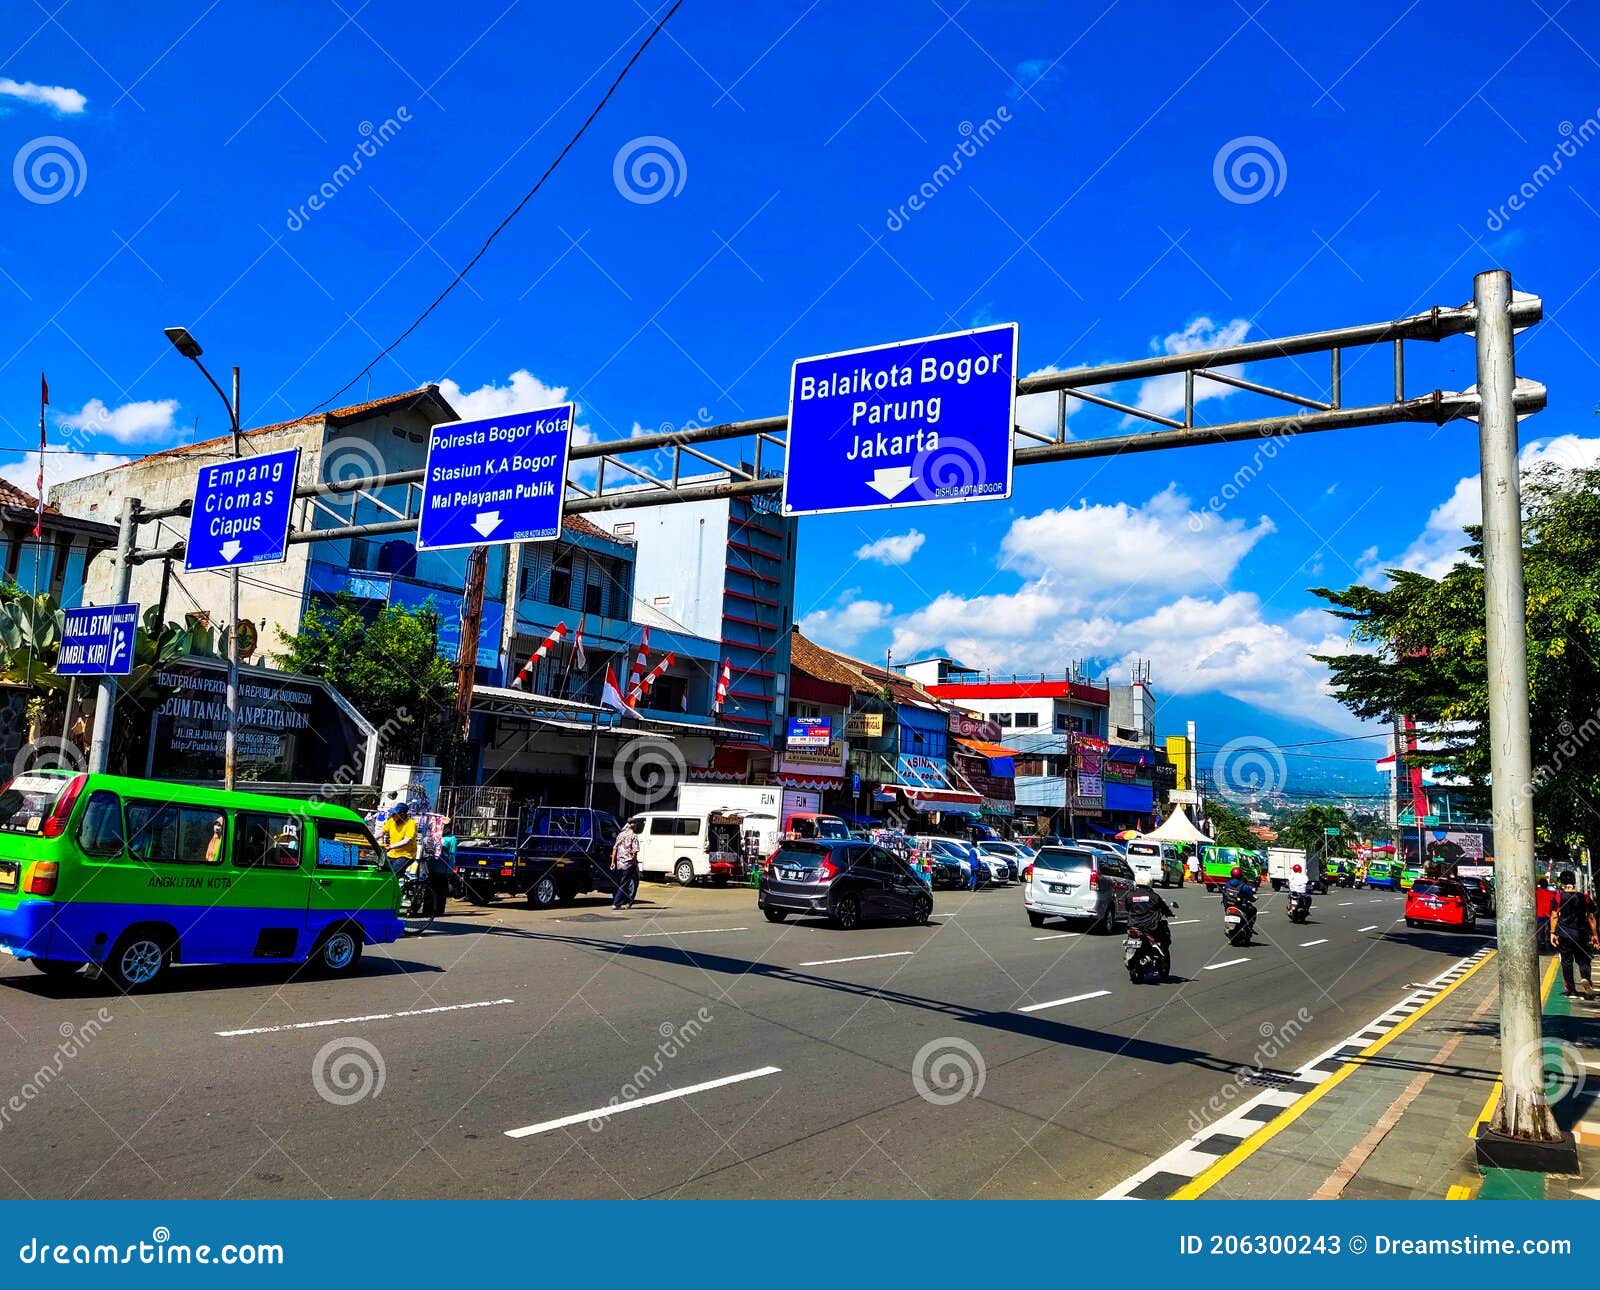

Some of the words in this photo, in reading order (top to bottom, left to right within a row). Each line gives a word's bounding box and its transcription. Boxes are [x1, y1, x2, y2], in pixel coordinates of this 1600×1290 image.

[800, 364, 912, 401] Balaikota
[920, 353, 1003, 385] Bogor
[851, 396, 942, 427] Parung
[431, 430, 485, 451] Polresta
[489, 425, 531, 443] Bogor
[535, 418, 568, 435] Kota
[846, 430, 940, 460] Jakarta
[208, 462, 283, 488] Empang
[432, 463, 481, 482] Stasiun
[485, 458, 509, 475] K.A
[512, 455, 557, 472] Bogor
[431, 494, 451, 509] Mal
[454, 488, 513, 507] Pelayanan
[515, 481, 555, 499] Publik
[935, 487, 959, 497] DISHUB
[960, 485, 977, 495] KOTA
[978, 482, 1003, 494] BOGOR
[205, 490, 274, 512] Ciomas
[210, 516, 261, 538] Ciapus
[64, 616, 88, 637] MALL
[90, 614, 112, 636] BTM
[124, 613, 135, 622] BTM
[58, 645, 85, 665] AMBIL
[87, 644, 107, 664] KIRI
[193, 700, 228, 721] TANAH
[253, 707, 310, 729] PERTANIAN
[906, 757, 939, 771] ASINAN
[795, 796, 807, 808] FJN
[282, 824, 297, 836] 03
[148, 877, 203, 889] ANGKUTAN
[207, 878, 232, 889] KOTA
